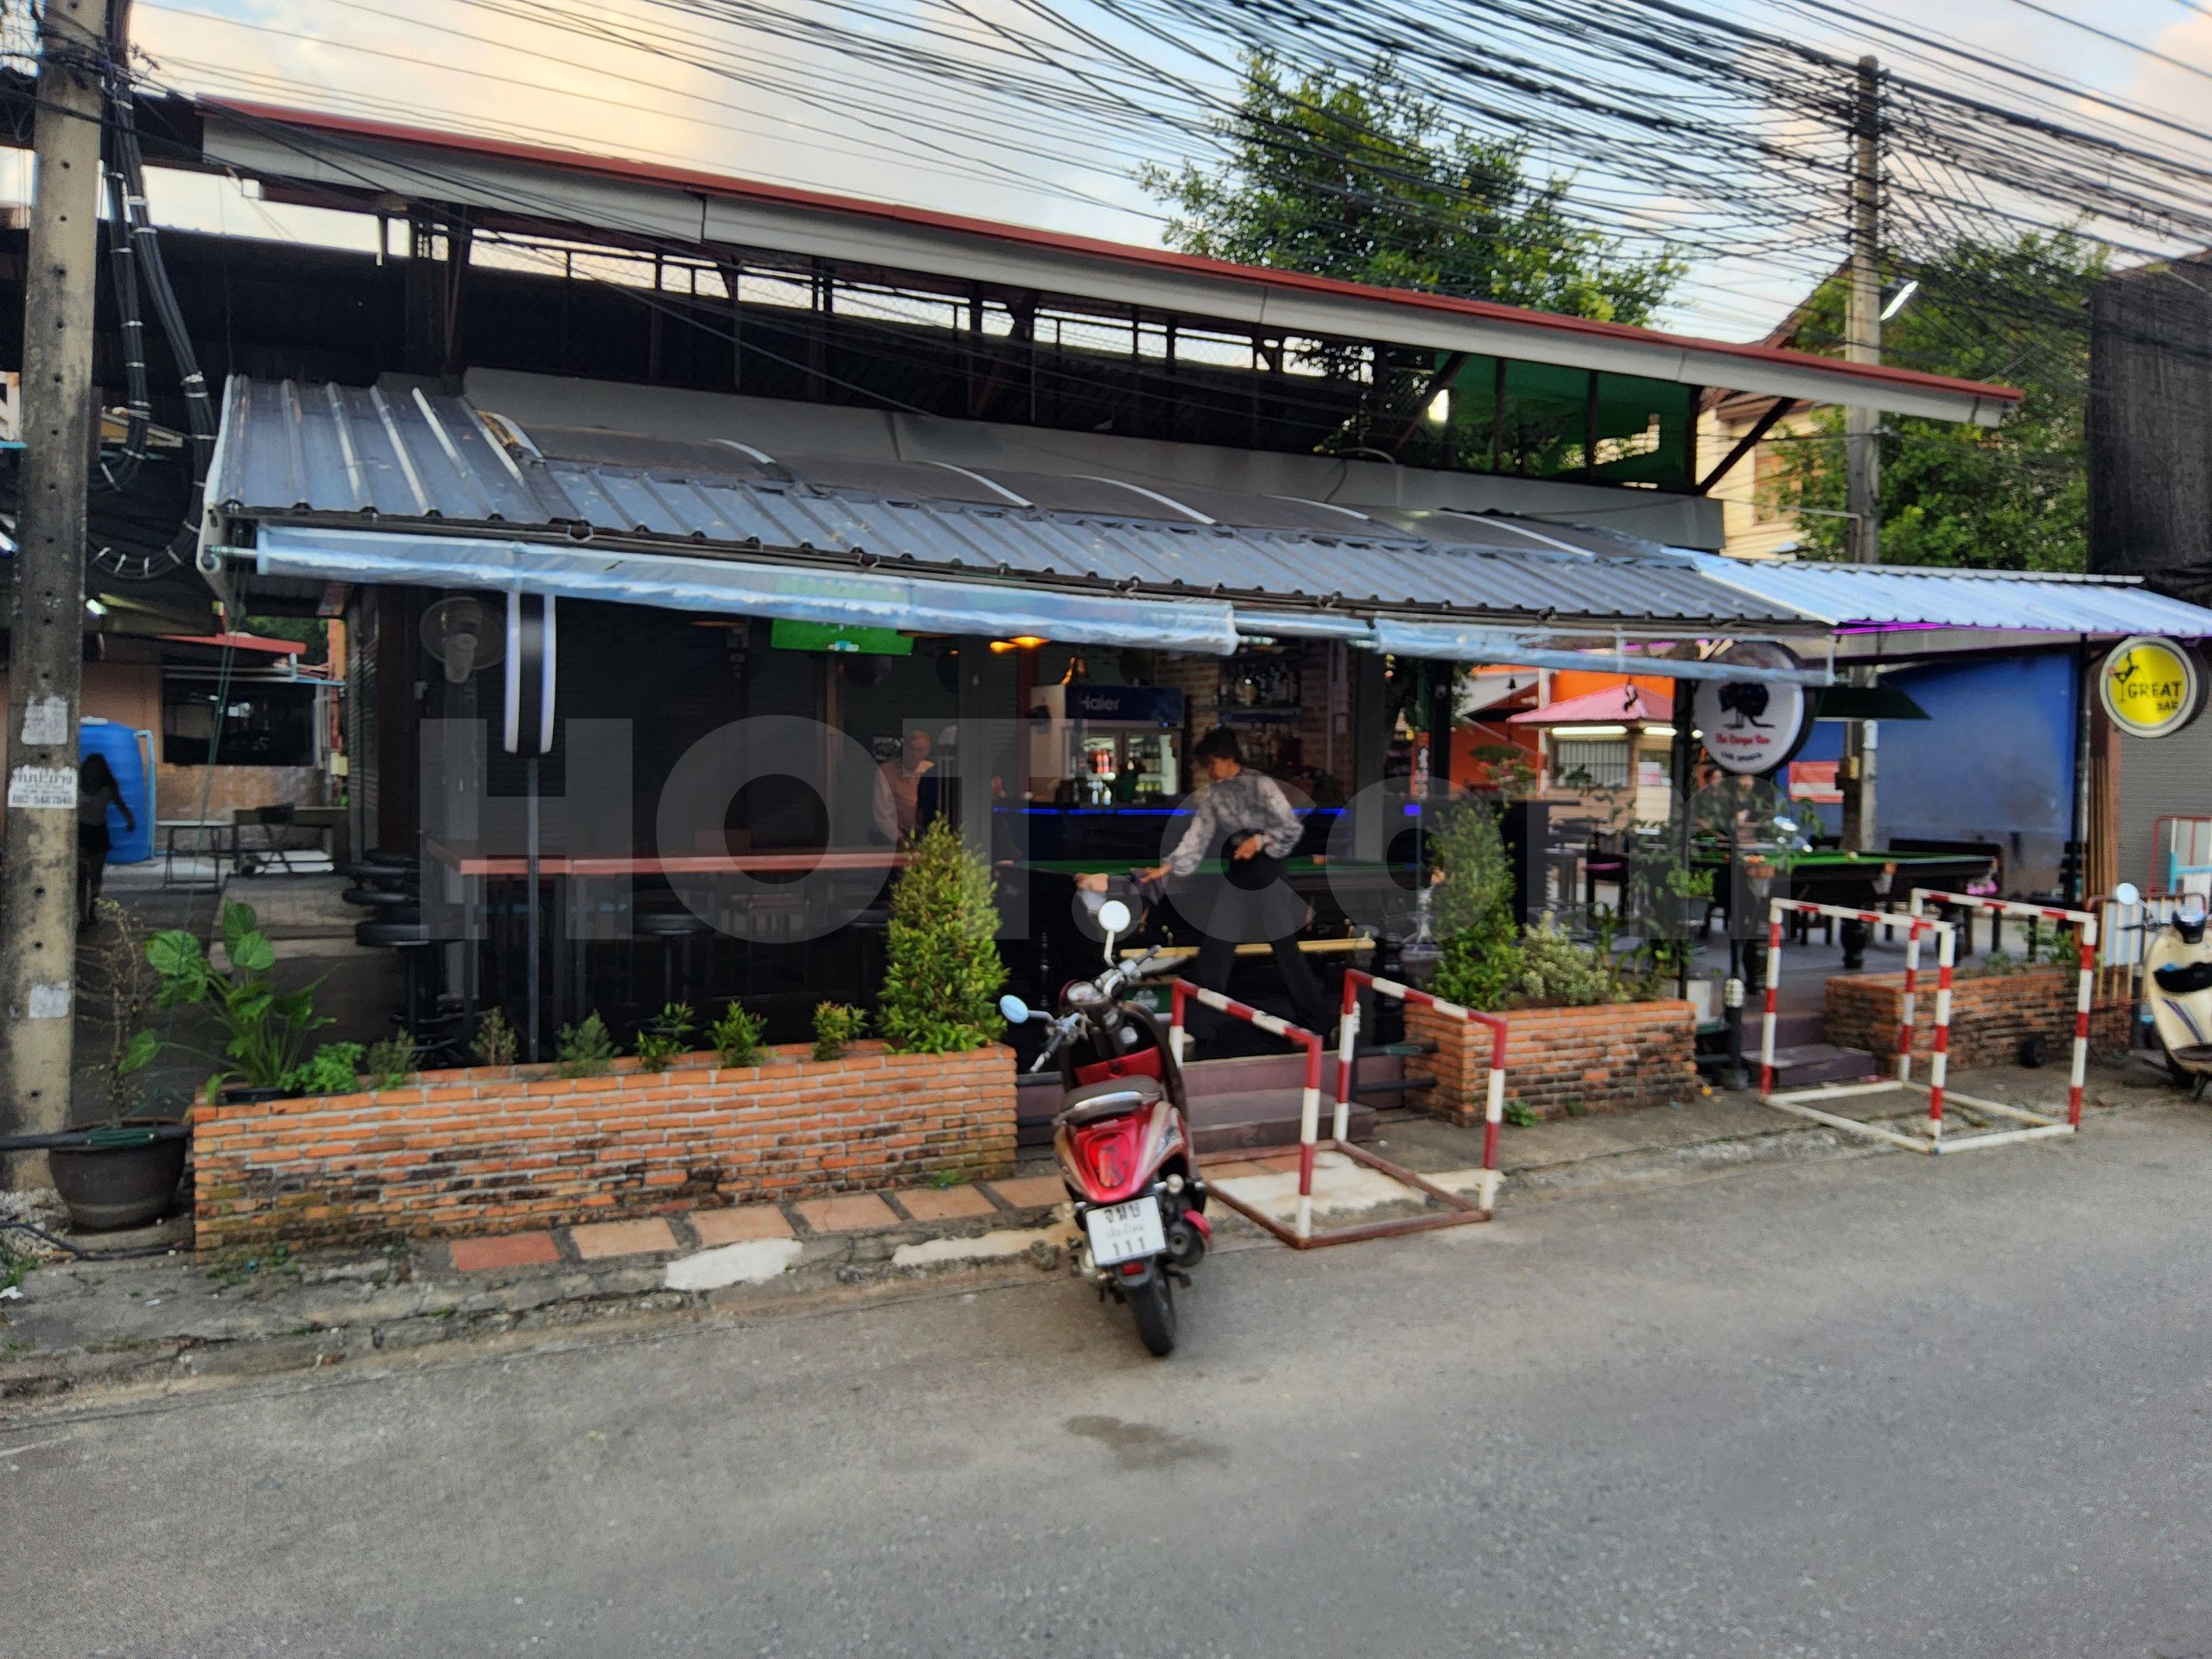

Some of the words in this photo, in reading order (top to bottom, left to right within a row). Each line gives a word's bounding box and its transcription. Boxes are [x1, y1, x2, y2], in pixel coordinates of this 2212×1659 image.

[2127, 680, 2182, 699] GREAT
[2157, 701, 2179, 711] BAR
[1113, 1236, 1146, 1256] 111
